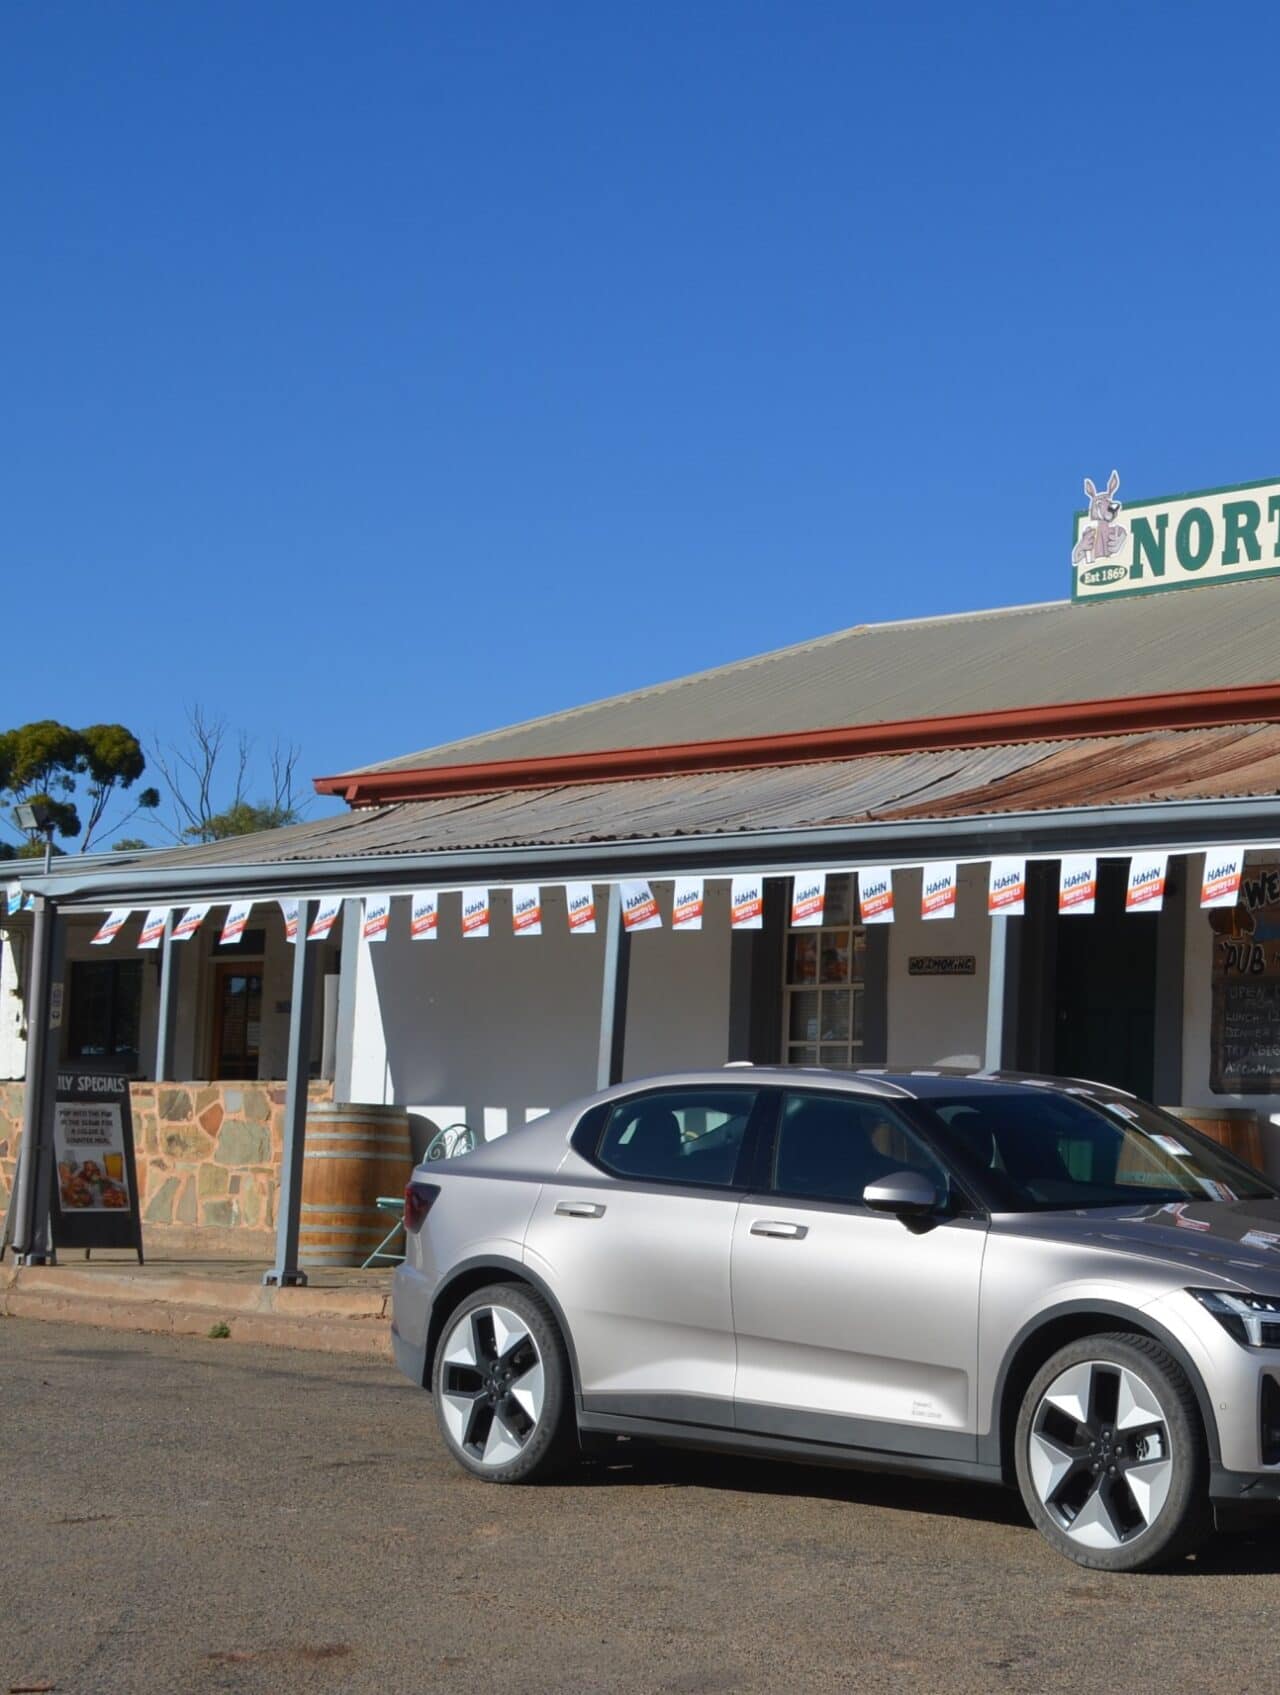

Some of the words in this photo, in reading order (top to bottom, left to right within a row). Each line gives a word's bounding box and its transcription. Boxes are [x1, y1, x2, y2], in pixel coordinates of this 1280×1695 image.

[1102, 567, 1125, 582] 1869
[1064, 870, 1091, 889] HAHN
[1132, 867, 1161, 886] HAHN
[1207, 862, 1237, 881] HAHN
[926, 876, 952, 896] HAHN
[993, 872, 1020, 890] HAHN
[676, 890, 699, 906] HAHN
[734, 889, 758, 906] HAHN
[796, 886, 820, 902] HAHN
[863, 881, 887, 899] HAHN
[464, 900, 486, 916] HAHN
[515, 899, 536, 914] HAHN
[570, 895, 590, 912] HAHN
[626, 891, 651, 909] HAHN
[367, 906, 386, 921] HAHN
[414, 903, 434, 918] HAHN
[910, 959, 924, 970] NO
[78, 1076, 126, 1093] SPECIALS
